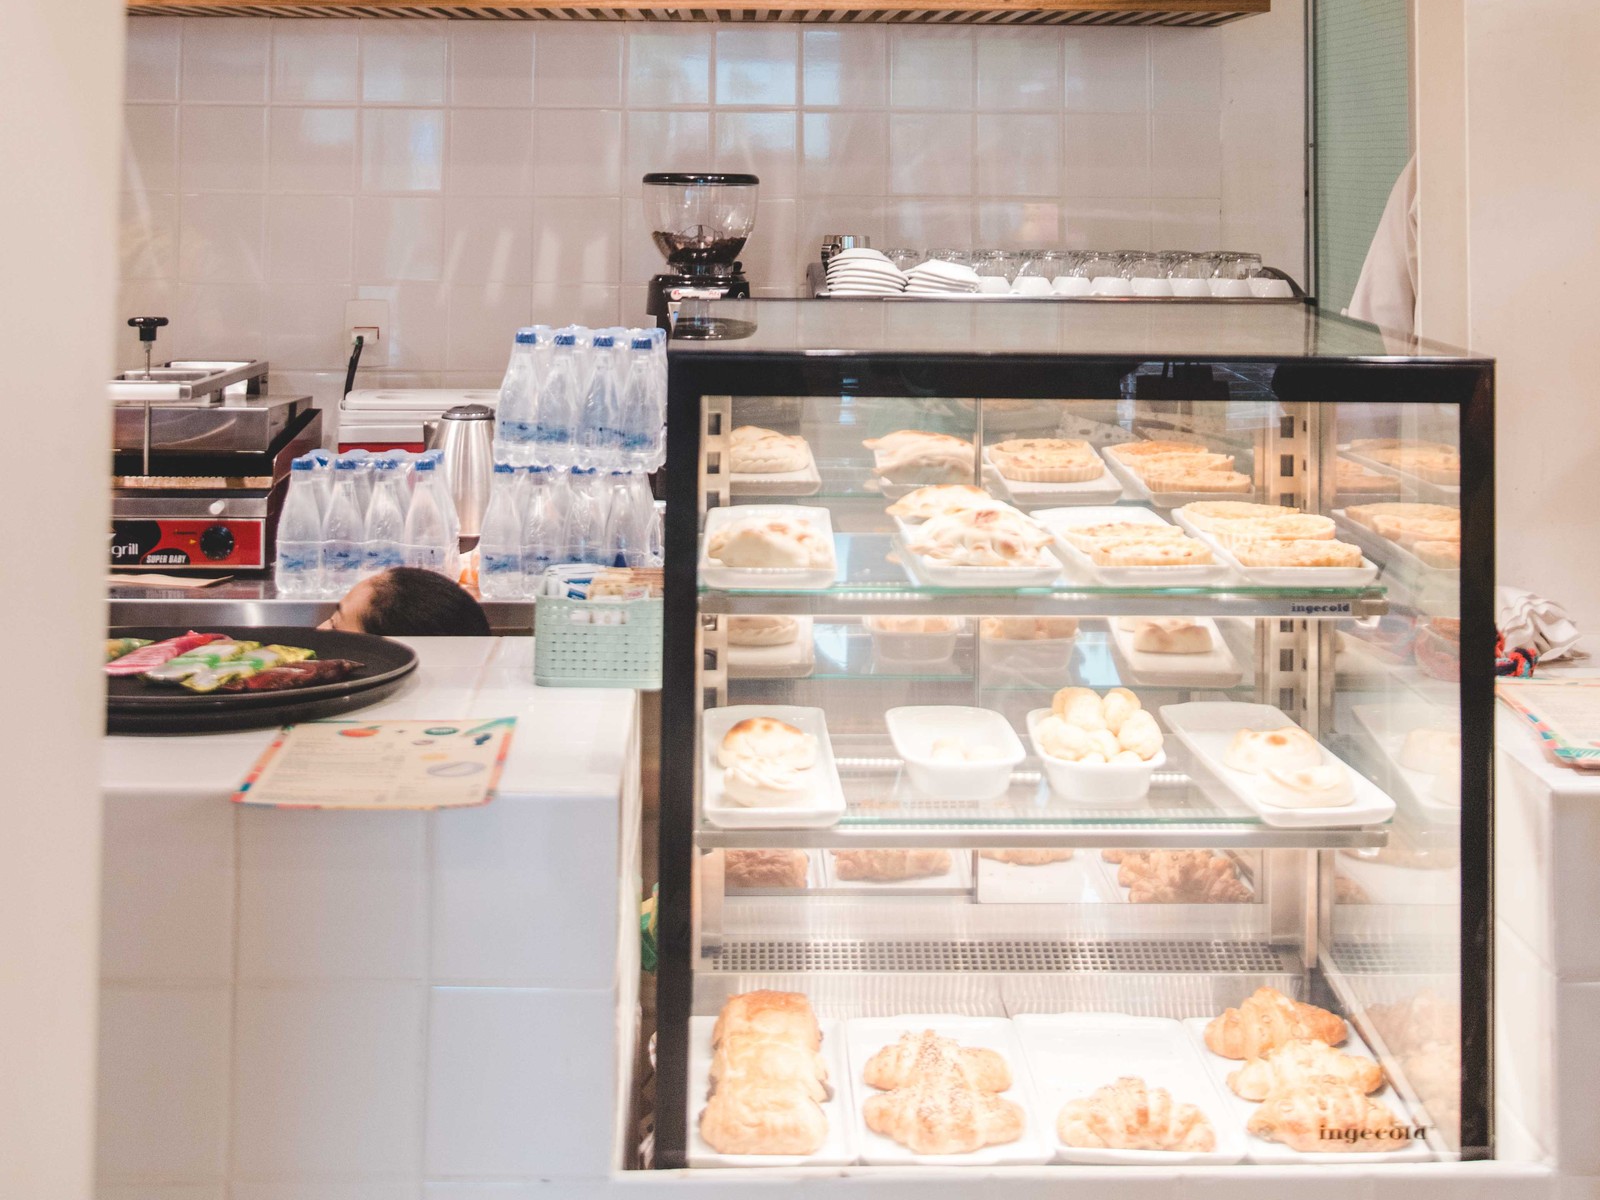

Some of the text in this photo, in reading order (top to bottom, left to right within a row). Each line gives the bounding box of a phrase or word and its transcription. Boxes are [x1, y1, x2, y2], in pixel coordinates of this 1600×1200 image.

[146, 555, 186, 563] SUPER BABY
[1291, 603, 1350, 614] ingecold
[1319, 1124, 1428, 1144] ingecold
